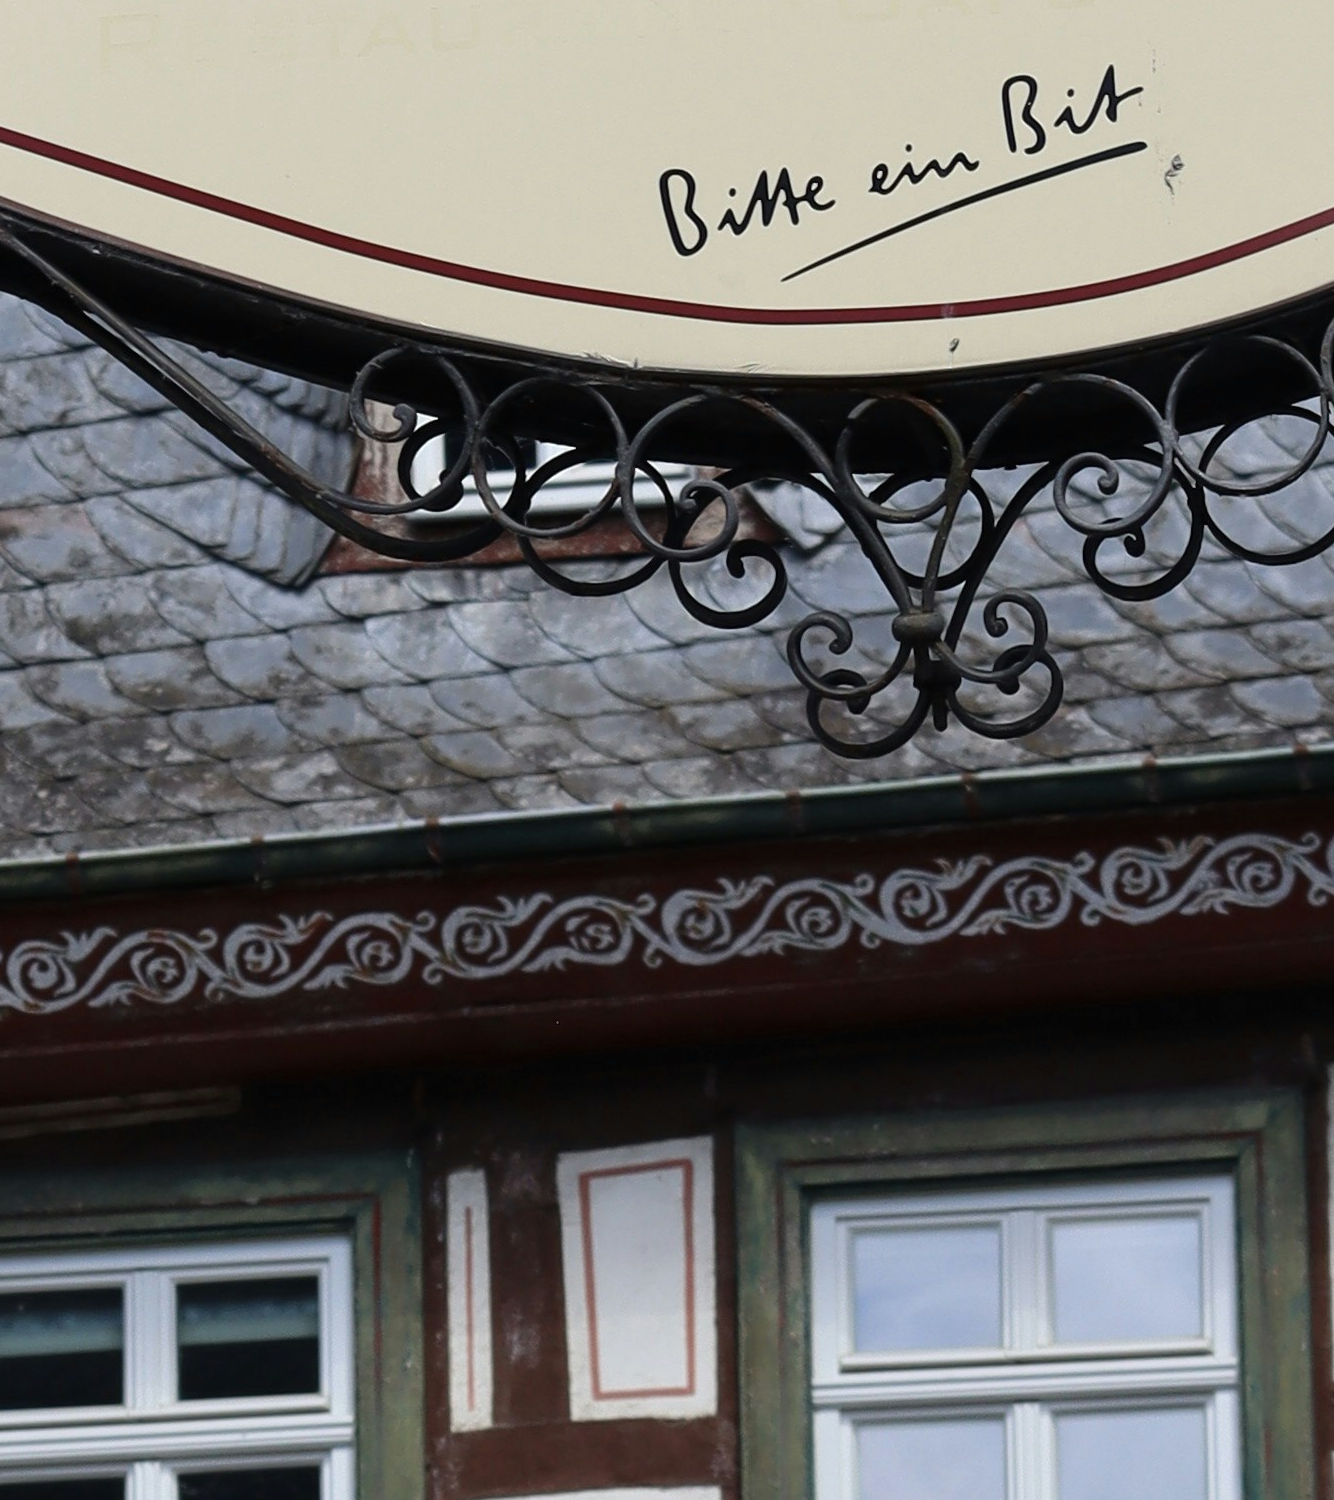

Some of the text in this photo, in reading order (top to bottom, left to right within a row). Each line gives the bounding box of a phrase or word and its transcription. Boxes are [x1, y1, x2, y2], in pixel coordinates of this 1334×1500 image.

[658, 64, 1144, 257] Bitte ein Bit
